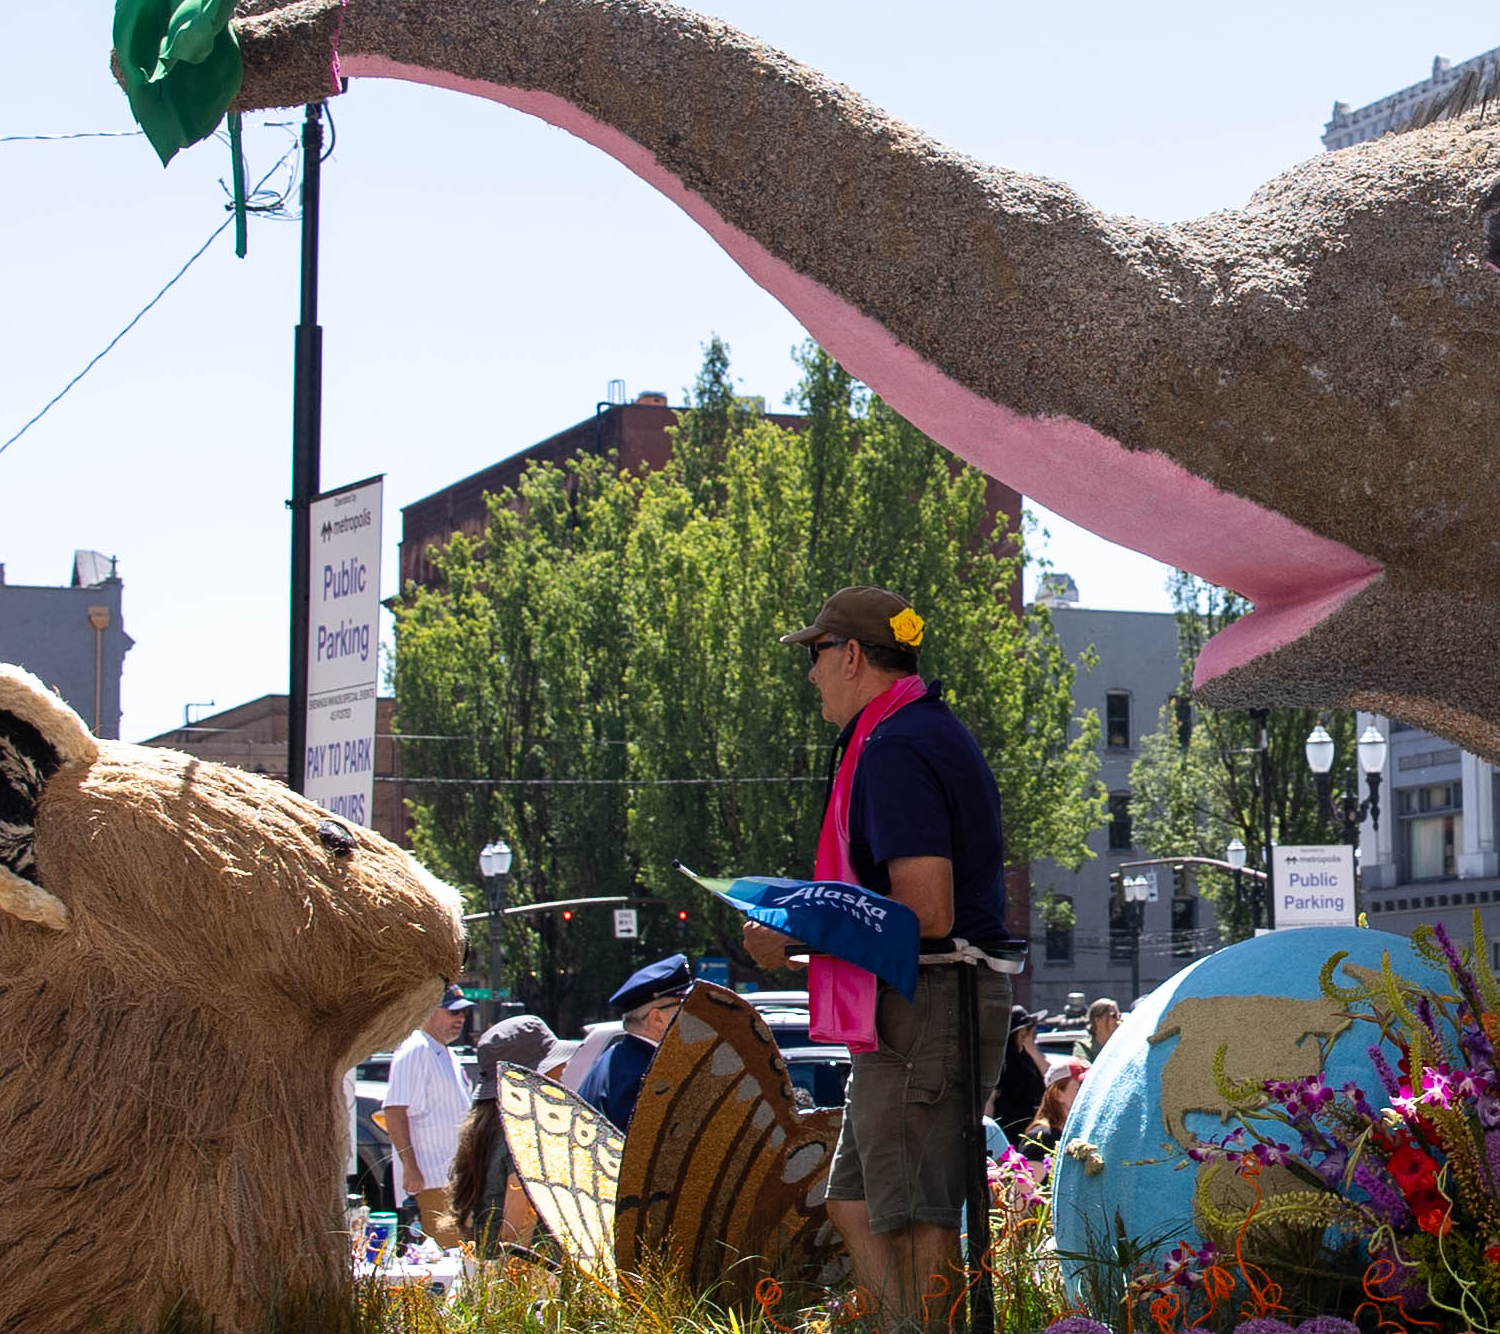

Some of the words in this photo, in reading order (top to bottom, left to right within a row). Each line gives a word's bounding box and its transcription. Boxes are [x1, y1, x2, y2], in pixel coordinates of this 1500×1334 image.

[333, 508, 371, 535] metropolis
[324, 556, 366, 601] Public
[317, 619, 369, 662] Parking
[307, 746, 326, 779] PAY
[328, 742, 341, 776] TO
[344, 737, 372, 774] PARK
[1289, 872, 1338, 887] Public
[772, 886, 888, 921] Alaska
[1284, 894, 1344, 912] Parking
